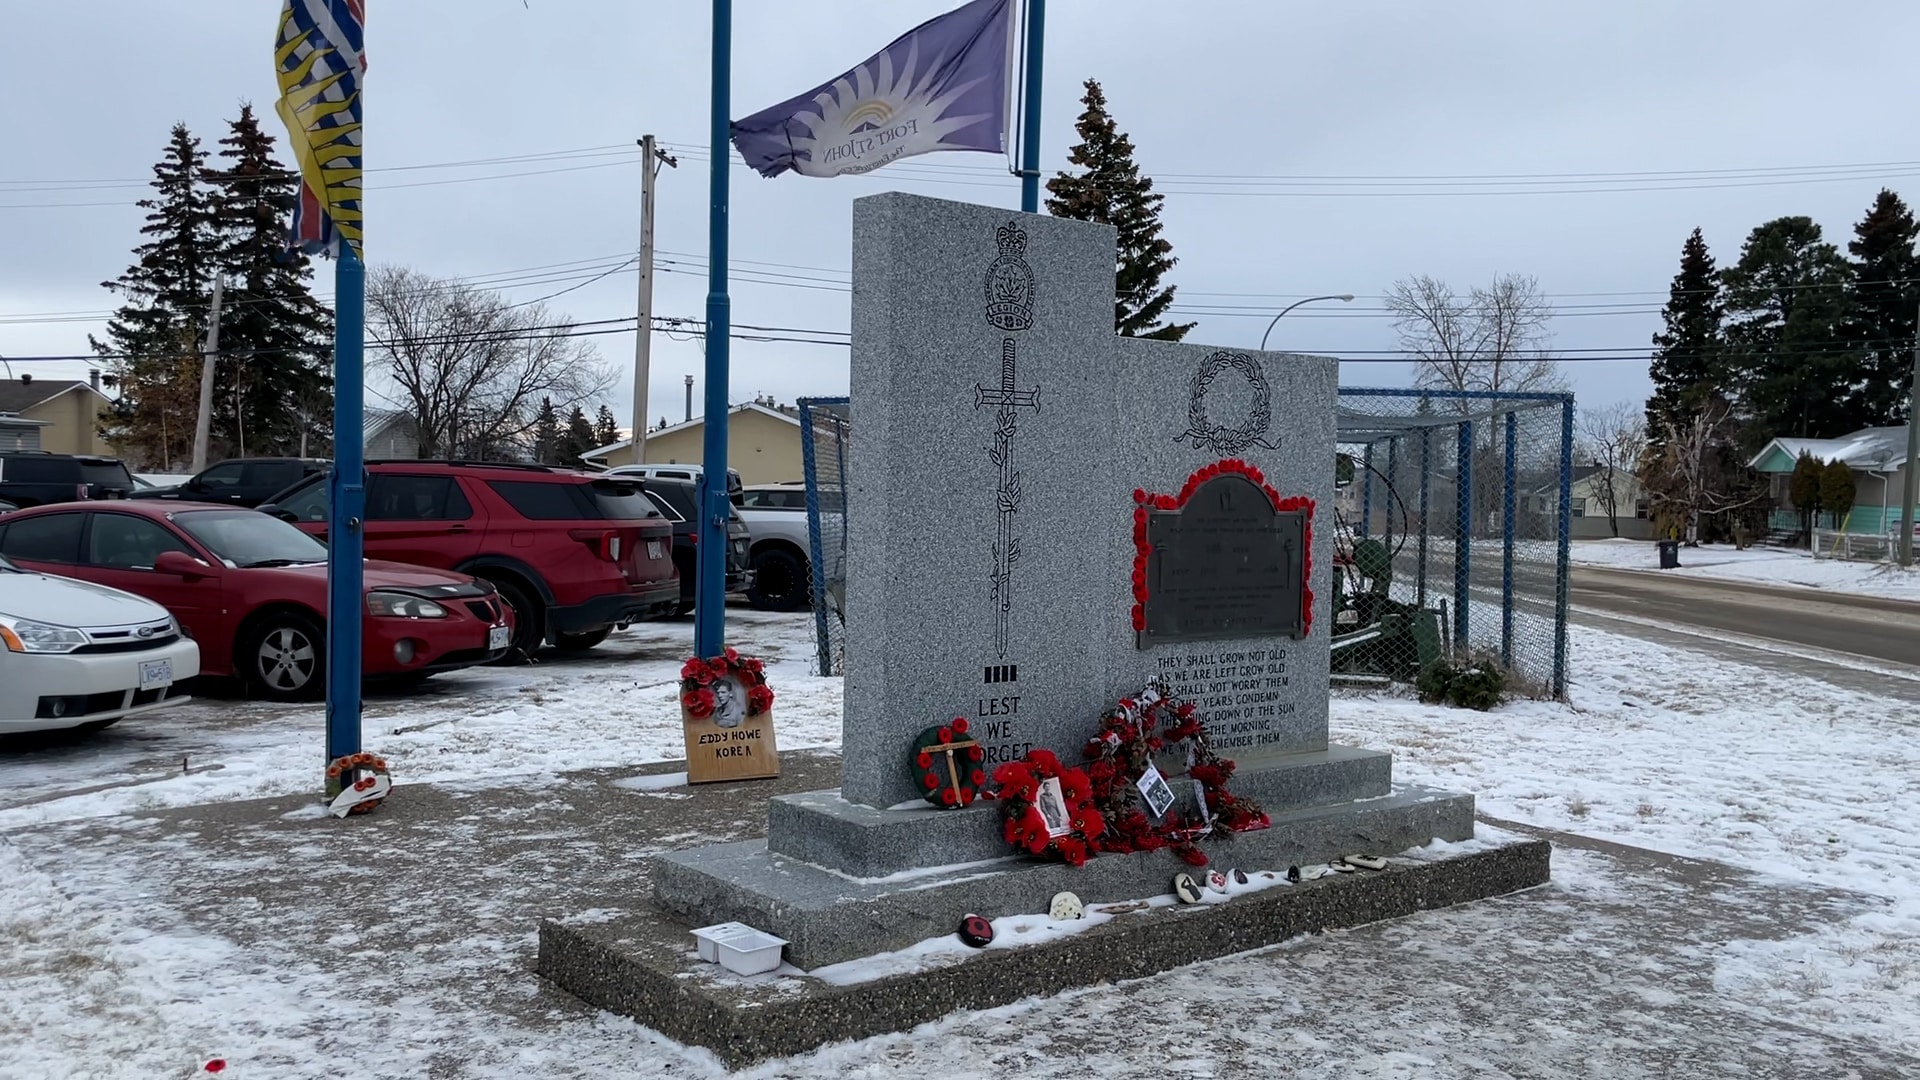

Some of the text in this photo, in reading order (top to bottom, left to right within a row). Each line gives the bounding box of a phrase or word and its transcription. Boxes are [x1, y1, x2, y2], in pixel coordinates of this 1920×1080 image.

[991, 304, 1027, 317] LEGION
[1157, 649, 1286, 669] THEY SHALL GROW NOT OLD
[1158, 663, 1285, 683] AS WE ARE LEFT GROW OLD
[1175, 684, 1206, 697] SHALL
[1209, 681, 1227, 693] NOT
[1265, 676, 1289, 688] THEM
[979, 696, 1021, 717] LEST
[1202, 696, 1233, 708] YEARS
[1236, 691, 1279, 705] CONDEMN
[1214, 709, 1240, 721] DOWN
[1243, 707, 1255, 718] OF
[1258, 705, 1275, 716] THE
[1278, 703, 1295, 715] SUN
[986, 721, 1012, 739] WE
[1209, 719, 1270, 736] THE MORNING
[698, 729, 761, 745] EDDY HOWE
[1160, 744, 1174, 755] WE
[1256, 732, 1280, 745] THEM
[715, 745, 752, 759] KOREA
